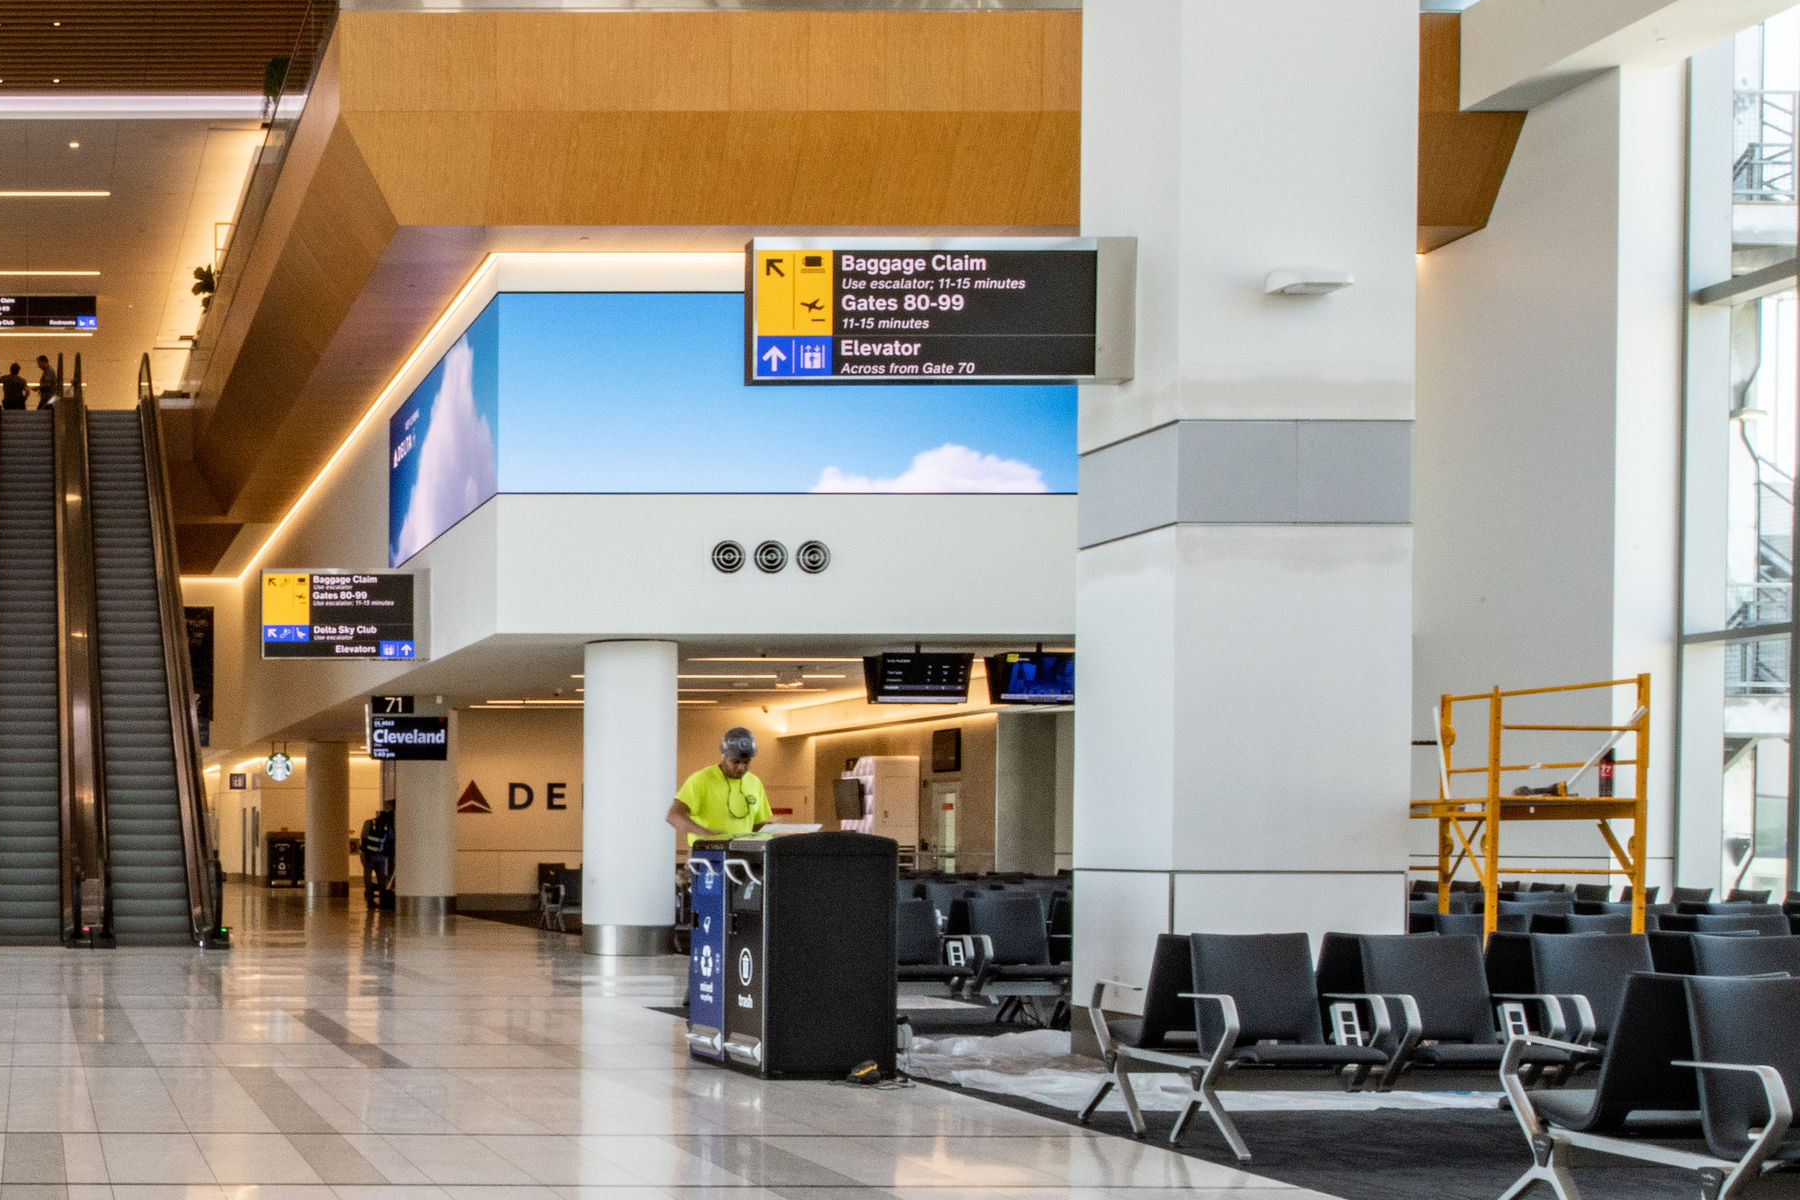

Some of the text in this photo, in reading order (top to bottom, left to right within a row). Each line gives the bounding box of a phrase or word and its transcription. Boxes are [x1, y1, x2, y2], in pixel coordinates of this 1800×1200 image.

[841, 254, 987, 274] Baggage Claim
[841, 277, 1026, 291] Use escalator; 11-15 minutes
[841, 294, 965, 311] Gates 80-99
[842, 317, 930, 330] 11-15 minutes
[840, 339, 922, 356] Elevator
[840, 362, 976, 375] Across from Gate 70
[312, 574, 378, 586] Baggage Claim
[312, 590, 368, 600] Gates 80-99
[313, 625, 378, 637] Delta Sky Club
[325, 633, 354, 641] escalator
[335, 644, 377, 654] Elevators
[384, 696, 403, 713] 71
[372, 728, 446, 744] Cleveland
[508, 782, 584, 811] DE
[738, 993, 753, 1009] trash
